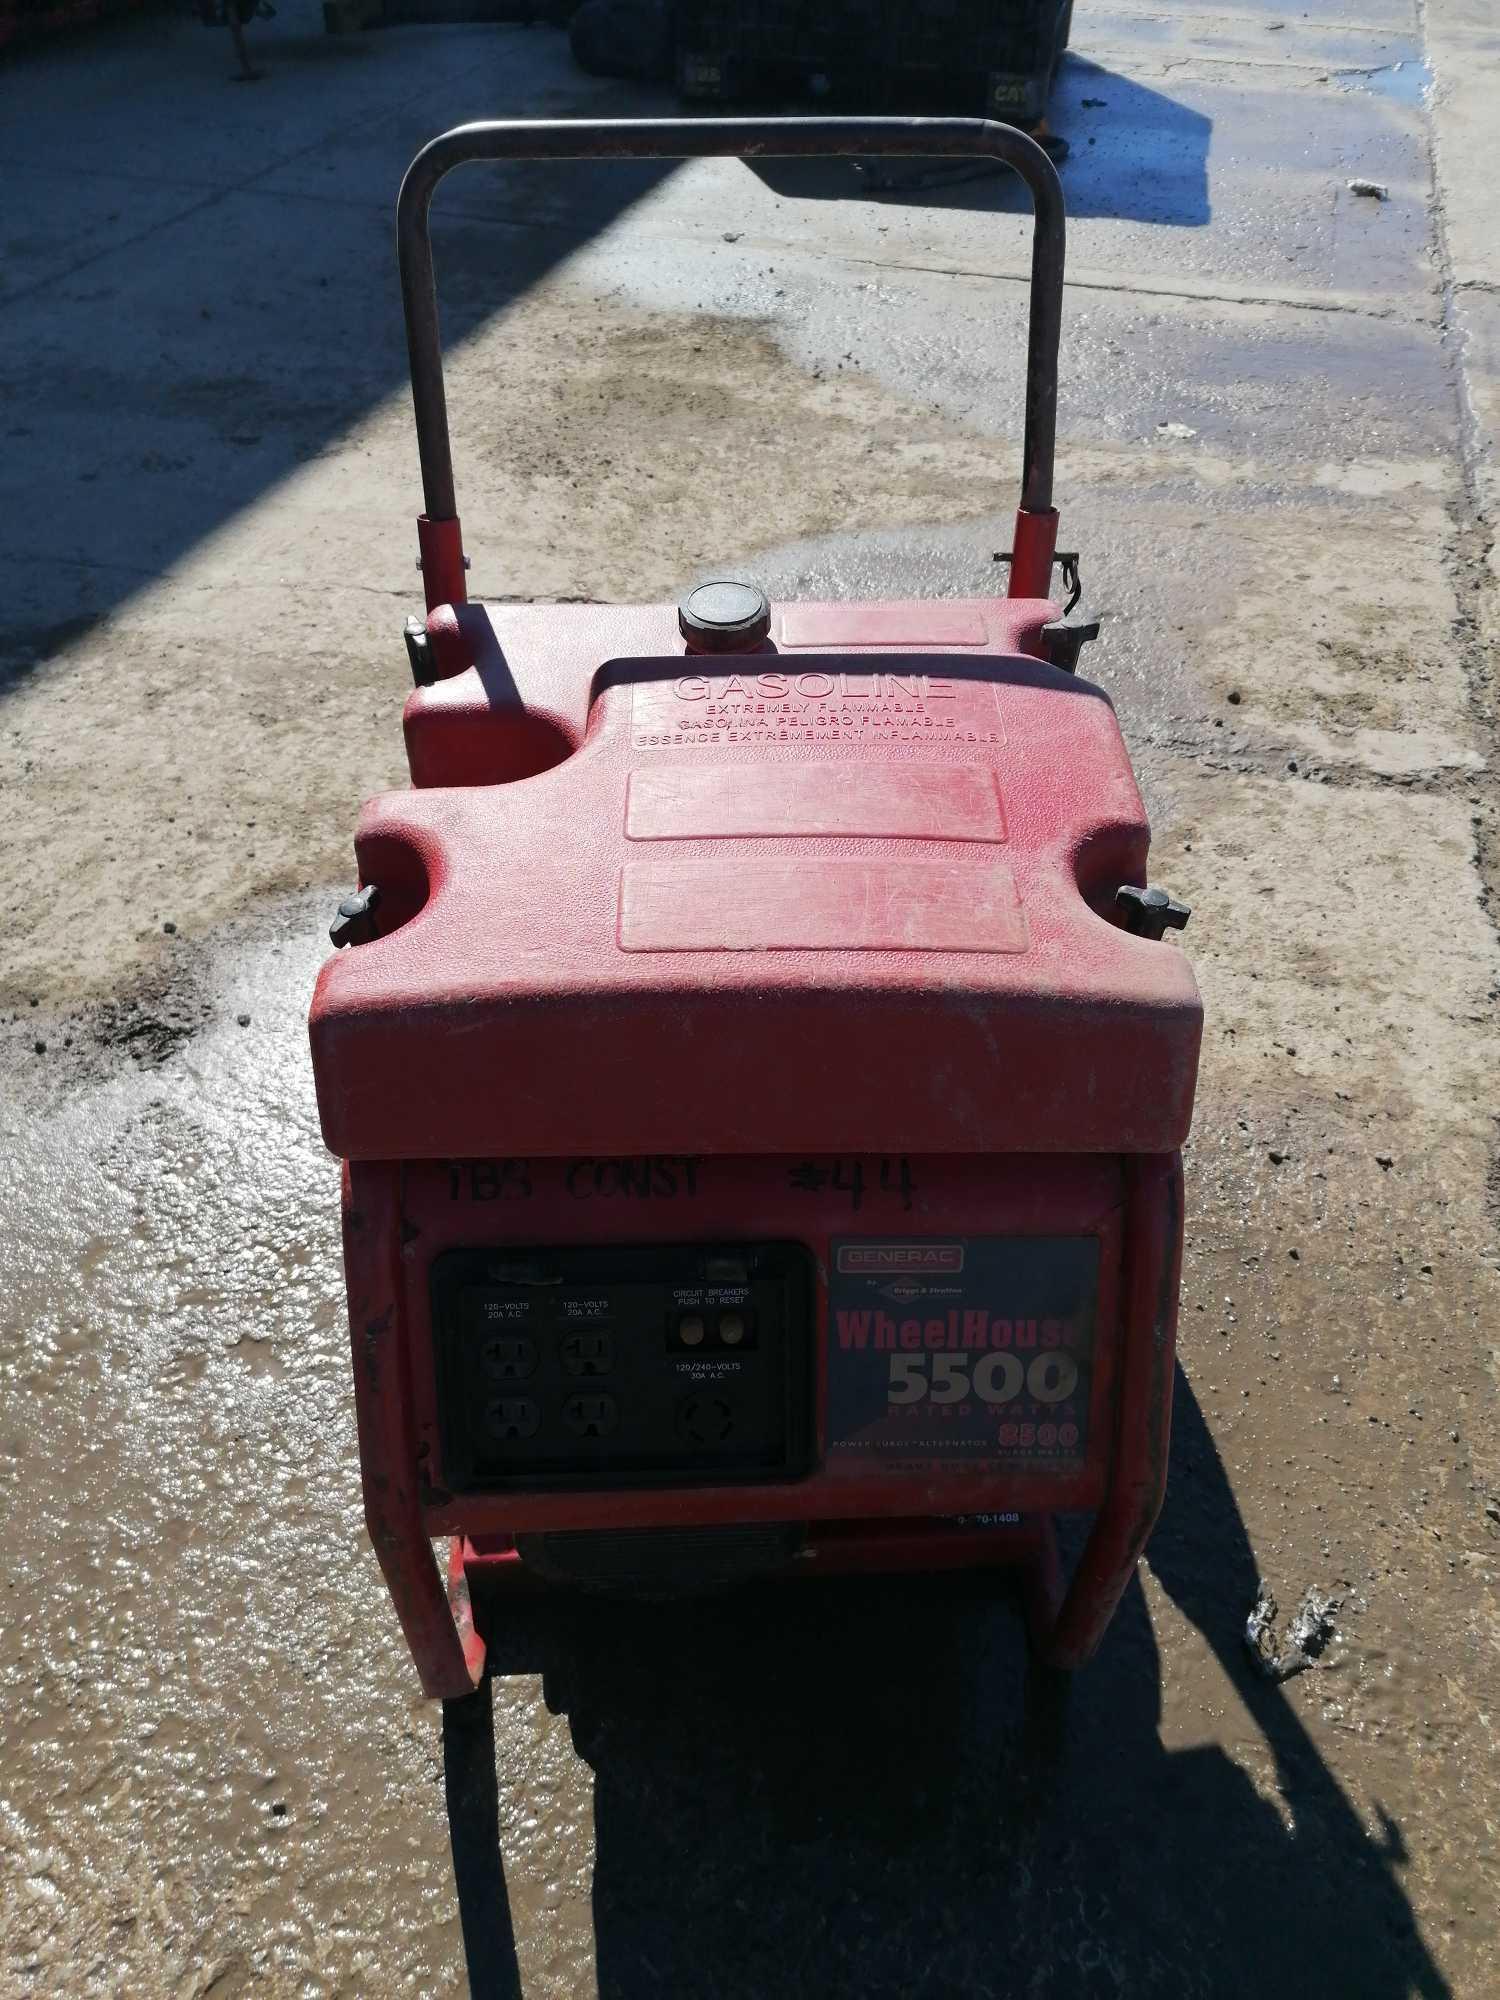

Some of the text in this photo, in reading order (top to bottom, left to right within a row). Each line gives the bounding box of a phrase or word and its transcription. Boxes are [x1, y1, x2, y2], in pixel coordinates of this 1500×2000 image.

[673, 673, 957, 701] GASOLINE
[706, 702, 925, 715] EXTREMELY FLAMMABLE
[678, 716, 956, 731] GASOLINA PELIGRO FLAMABLE
[636, 732, 721, 746] ESSENCE
[873, 730, 1000, 743] INFLAMMABLE
[564, 1157, 704, 1200] CONST
[787, 1158, 919, 1210] #44
[848, 1250, 955, 1263] GENERAC
[673, 1287, 749, 1298] CIRCUIT BREAKERS
[483, 1302, 529, 1311] 120-VOLTS
[563, 1300, 608, 1309] 120-VOLTS
[678, 1297, 700, 1305] PUSH
[720, 1296, 744, 1304] RESET
[675, 1361, 742, 1373] 120/240-VOLTS
[888, 1351, 1079, 1404] 5500
[887, 1403, 1077, 1417] RATED WATTS
[997, 1423, 1080, 1447] 8500
[832, 1439, 871, 1448] POWER
